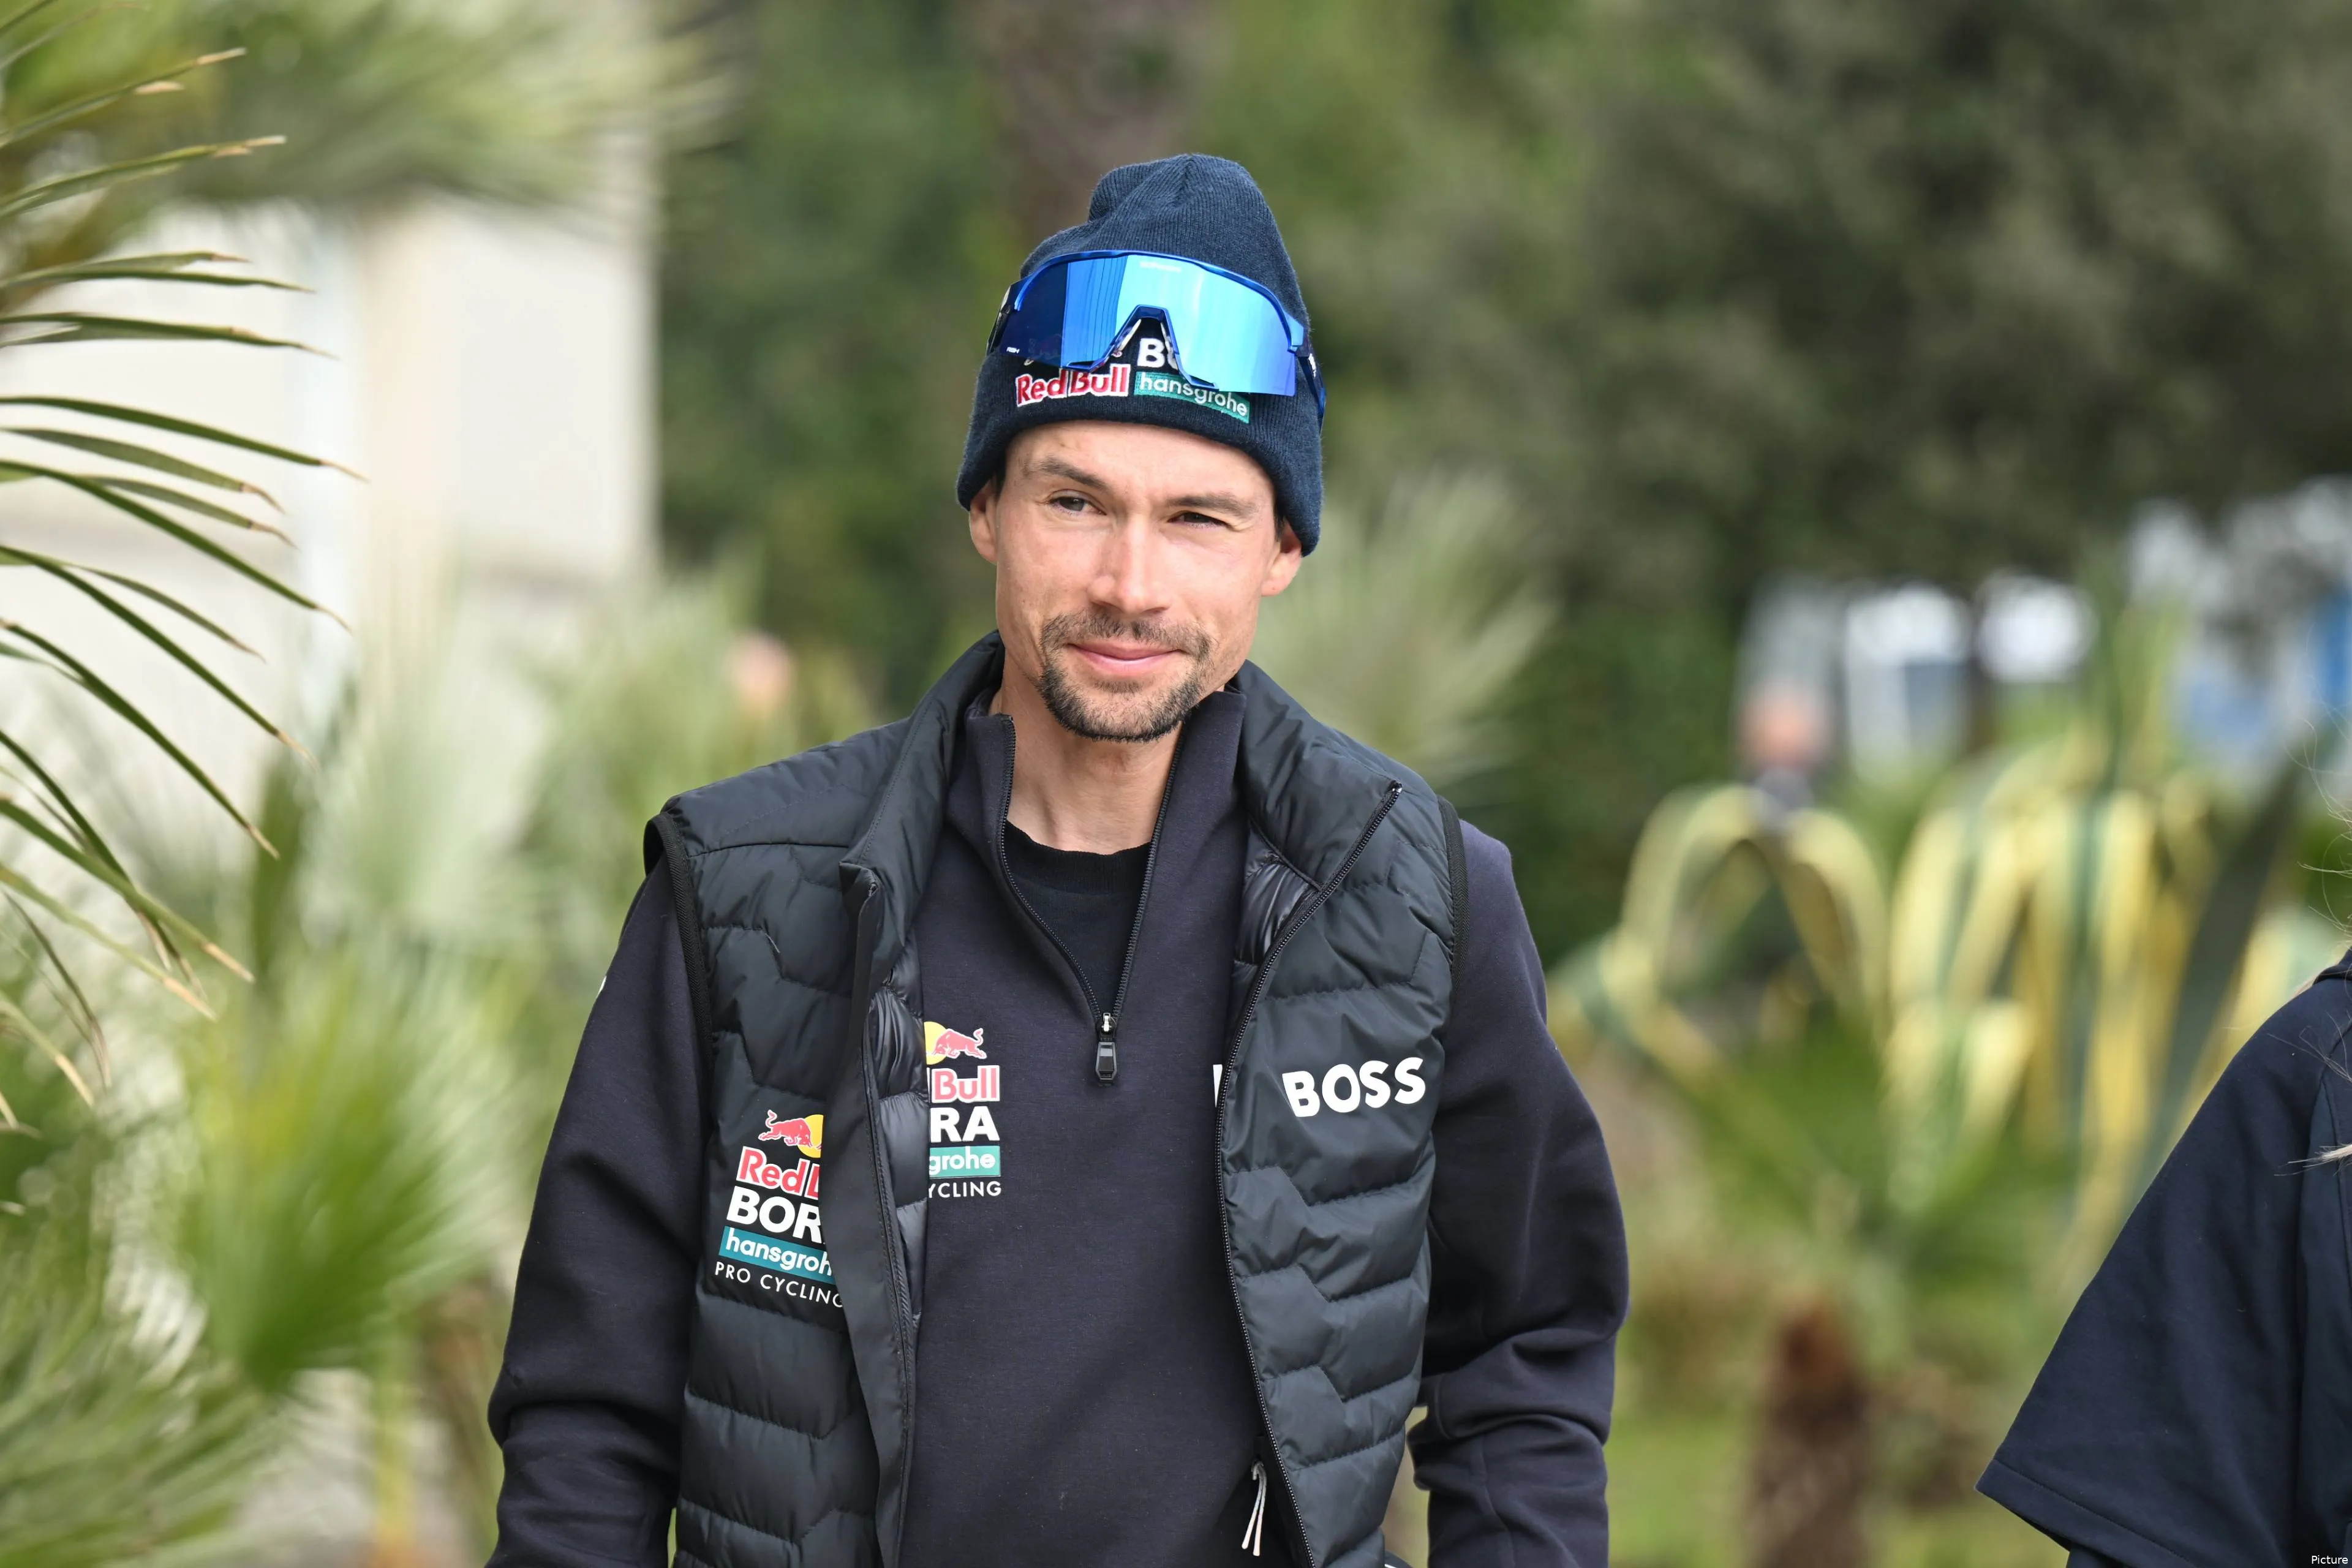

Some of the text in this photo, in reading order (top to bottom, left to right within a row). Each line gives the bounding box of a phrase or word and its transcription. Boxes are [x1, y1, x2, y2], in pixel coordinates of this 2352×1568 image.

[1016, 364, 1131, 407] Red Bull
[1140, 372, 1248, 417] hansgrohe
[932, 1065, 1000, 1103] Bull
[1282, 1057, 1425, 1117] BOSS
[736, 1146, 810, 1196] Red
[726, 1186, 826, 1244] BOR
[715, 1262, 843, 1308] PRO CYCLING
